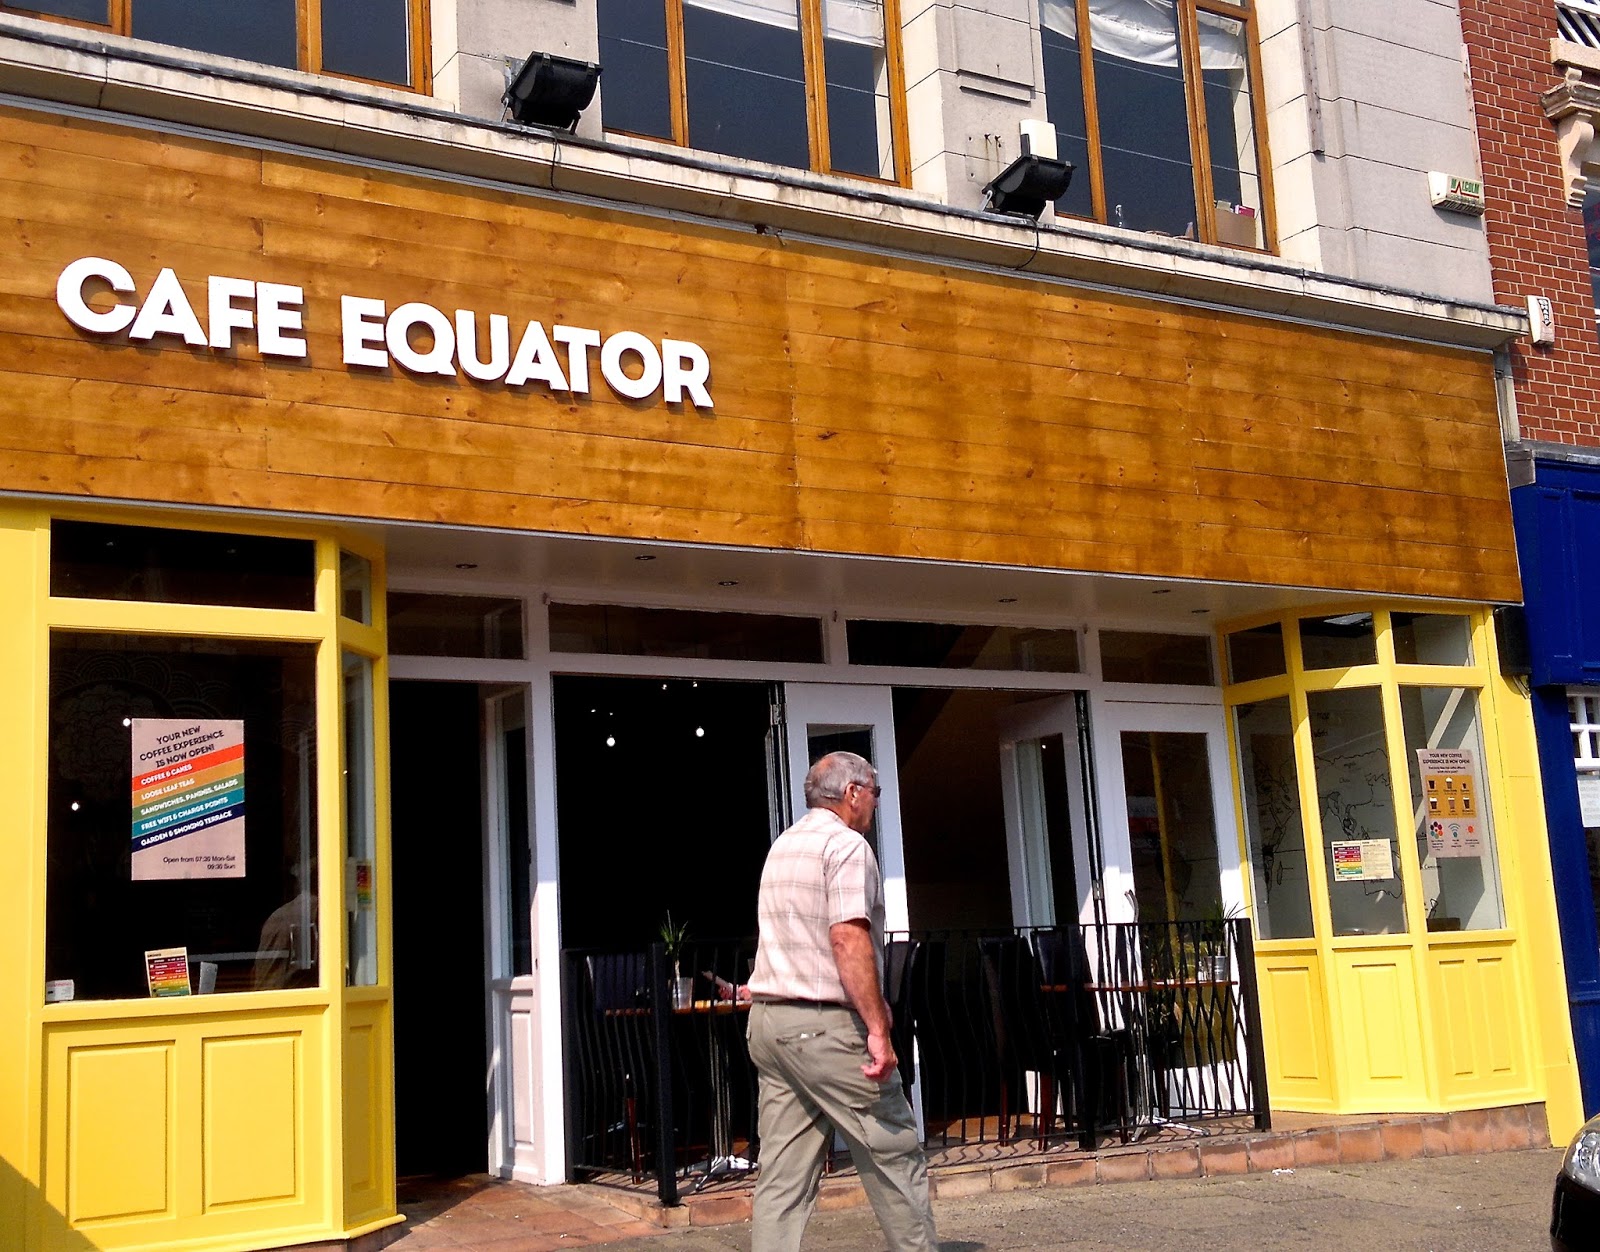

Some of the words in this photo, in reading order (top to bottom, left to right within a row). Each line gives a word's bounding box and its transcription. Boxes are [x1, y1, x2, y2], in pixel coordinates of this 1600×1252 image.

[55, 256, 308, 358] CAFE
[340, 294, 714, 409] EQUATOR
[140, 745, 173, 761] COFFEE
[173, 730, 224, 750] EXPERIENCE
[156, 732, 181, 744] YOUR
[182, 726, 201, 737] NEW
[156, 760, 166, 768] IS
[166, 752, 187, 765] NOW
[189, 744, 215, 757] OPEN!
[141, 772, 165, 785] COFFEE
[171, 764, 193, 775] CAKES
[213, 779, 238, 791] SALADS
[141, 789, 163, 800] LOOSE
[163, 783, 178, 793] LEAF
[178, 778, 195, 787] TEAS
[141, 820, 157, 830] FREE
[157, 815, 173, 824] WIFI
[177, 804, 204, 818] CHARGE
[204, 797, 229, 810] POINTS
[141, 832, 169, 846] GARDEN
[173, 820, 204, 835] SMOKING
[204, 810, 233, 824] TERRACE
[163, 856, 179, 865] Open
